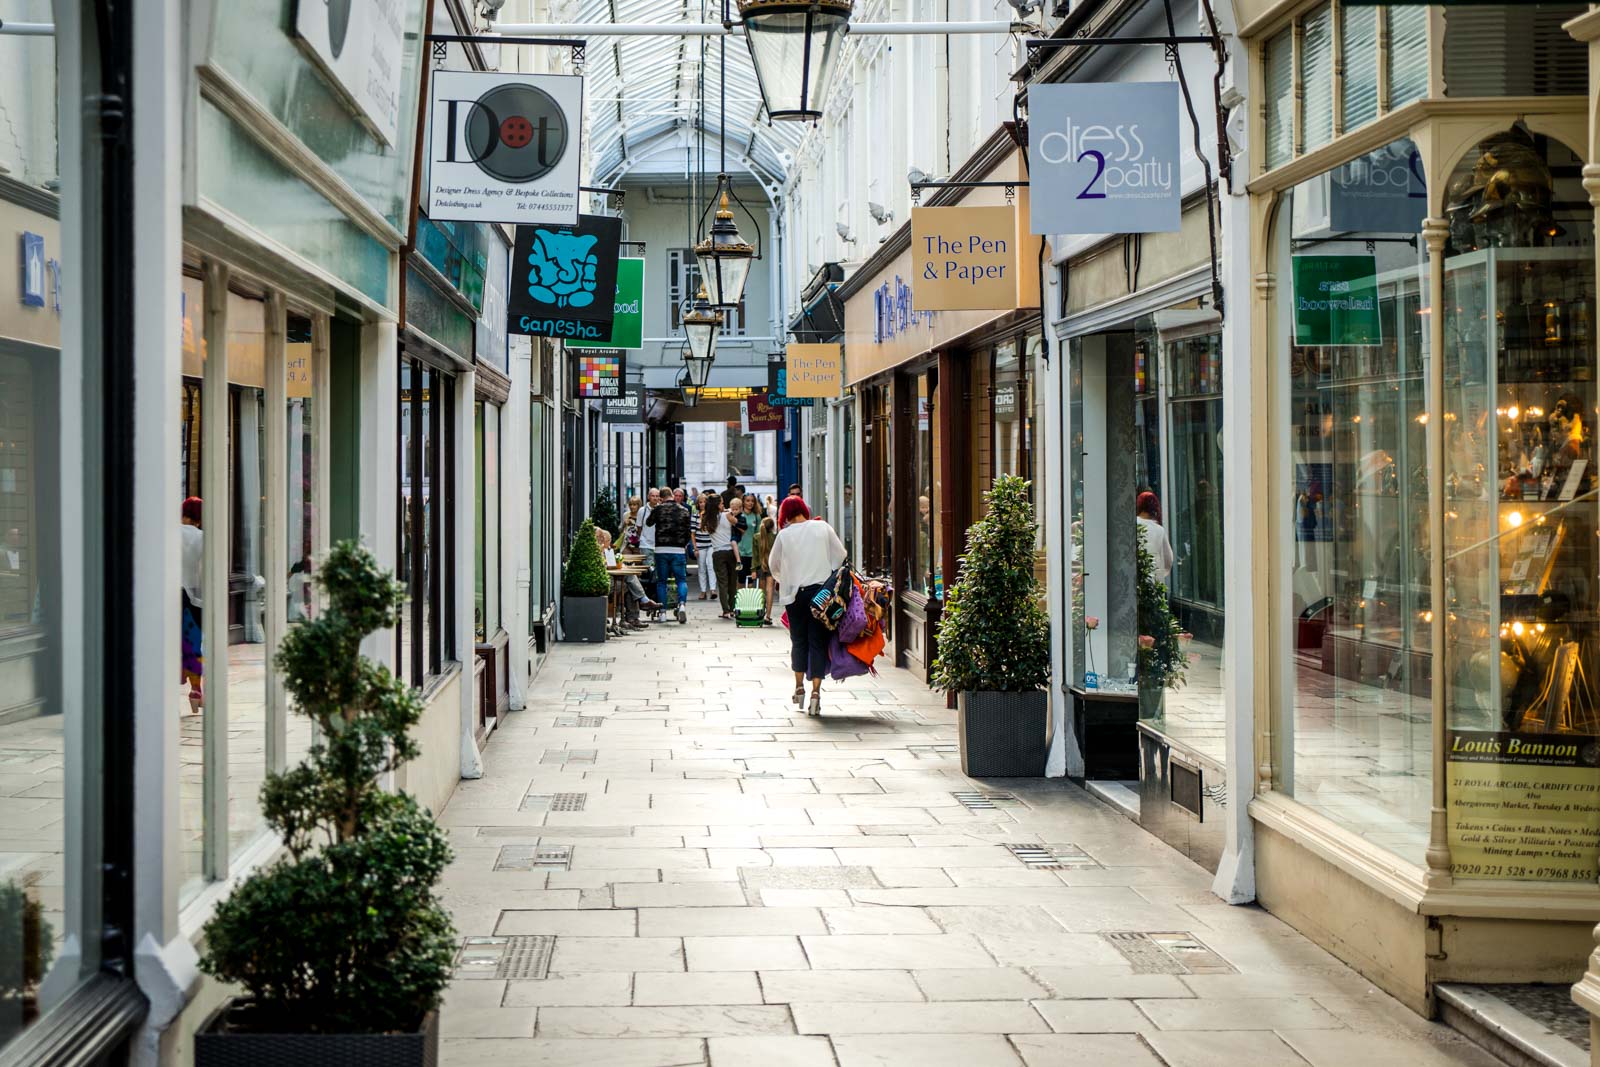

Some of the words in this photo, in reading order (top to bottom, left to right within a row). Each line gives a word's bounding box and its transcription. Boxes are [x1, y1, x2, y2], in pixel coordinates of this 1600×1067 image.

[1040, 116, 1144, 164] dress
[1076, 150, 1107, 200] 2
[1104, 156, 1172, 194] party
[434, 185, 462, 195] Designer
[463, 187, 481, 195] Dress
[482, 187, 503, 198] Agency
[505, 188, 514, 196] &
[515, 189, 540, 199] Bespoke
[541, 189, 574, 198] Collections
[923, 235, 963, 255] The
[969, 235, 1007, 255] Pen
[923, 261, 938, 280] &
[945, 261, 1006, 285] Paper
[519, 316, 602, 339] Ganesha
[793, 358, 813, 369] The
[815, 358, 836, 369] Pen
[599, 377, 619, 387] MORGAN
[792, 373, 801, 382] &
[803, 371, 836, 385] Paper
[599, 387, 619, 397] QUARTER
[1452, 736, 1502, 753] Louis
[1506, 738, 1577, 757] Bannon
[1453, 779, 1463, 787] 21
[1494, 781, 1531, 790] ARCADE,
[1533, 782, 1572, 791] CARDIFF
[1573, 783, 1596, 791] CF10
[1454, 799, 1500, 810] Abergavenny
[1502, 801, 1531, 810] Market,
[1533, 802, 1562, 812] Tuesday
[1455, 822, 1484, 832] Tokens
[1491, 824, 1516, 833] Coins
[1524, 825, 1547, 834] Bank
[1550, 826, 1572, 835] Notes
[1460, 834, 1481, 843] Gold
[1483, 835, 1490, 843] &
[1492, 836, 1517, 844] Silver
[1519, 837, 1556, 846] Militaria
[1482, 846, 1513, 857] Mining
[1515, 848, 1543, 859] Lamps
[1551, 849, 1581, 859] Checks
[1483, 864, 1502, 875] 221
[1506, 866, 1526, 876] 528
[1536, 867, 1569, 879] 07968
[1571, 869, 1592, 880] 855
